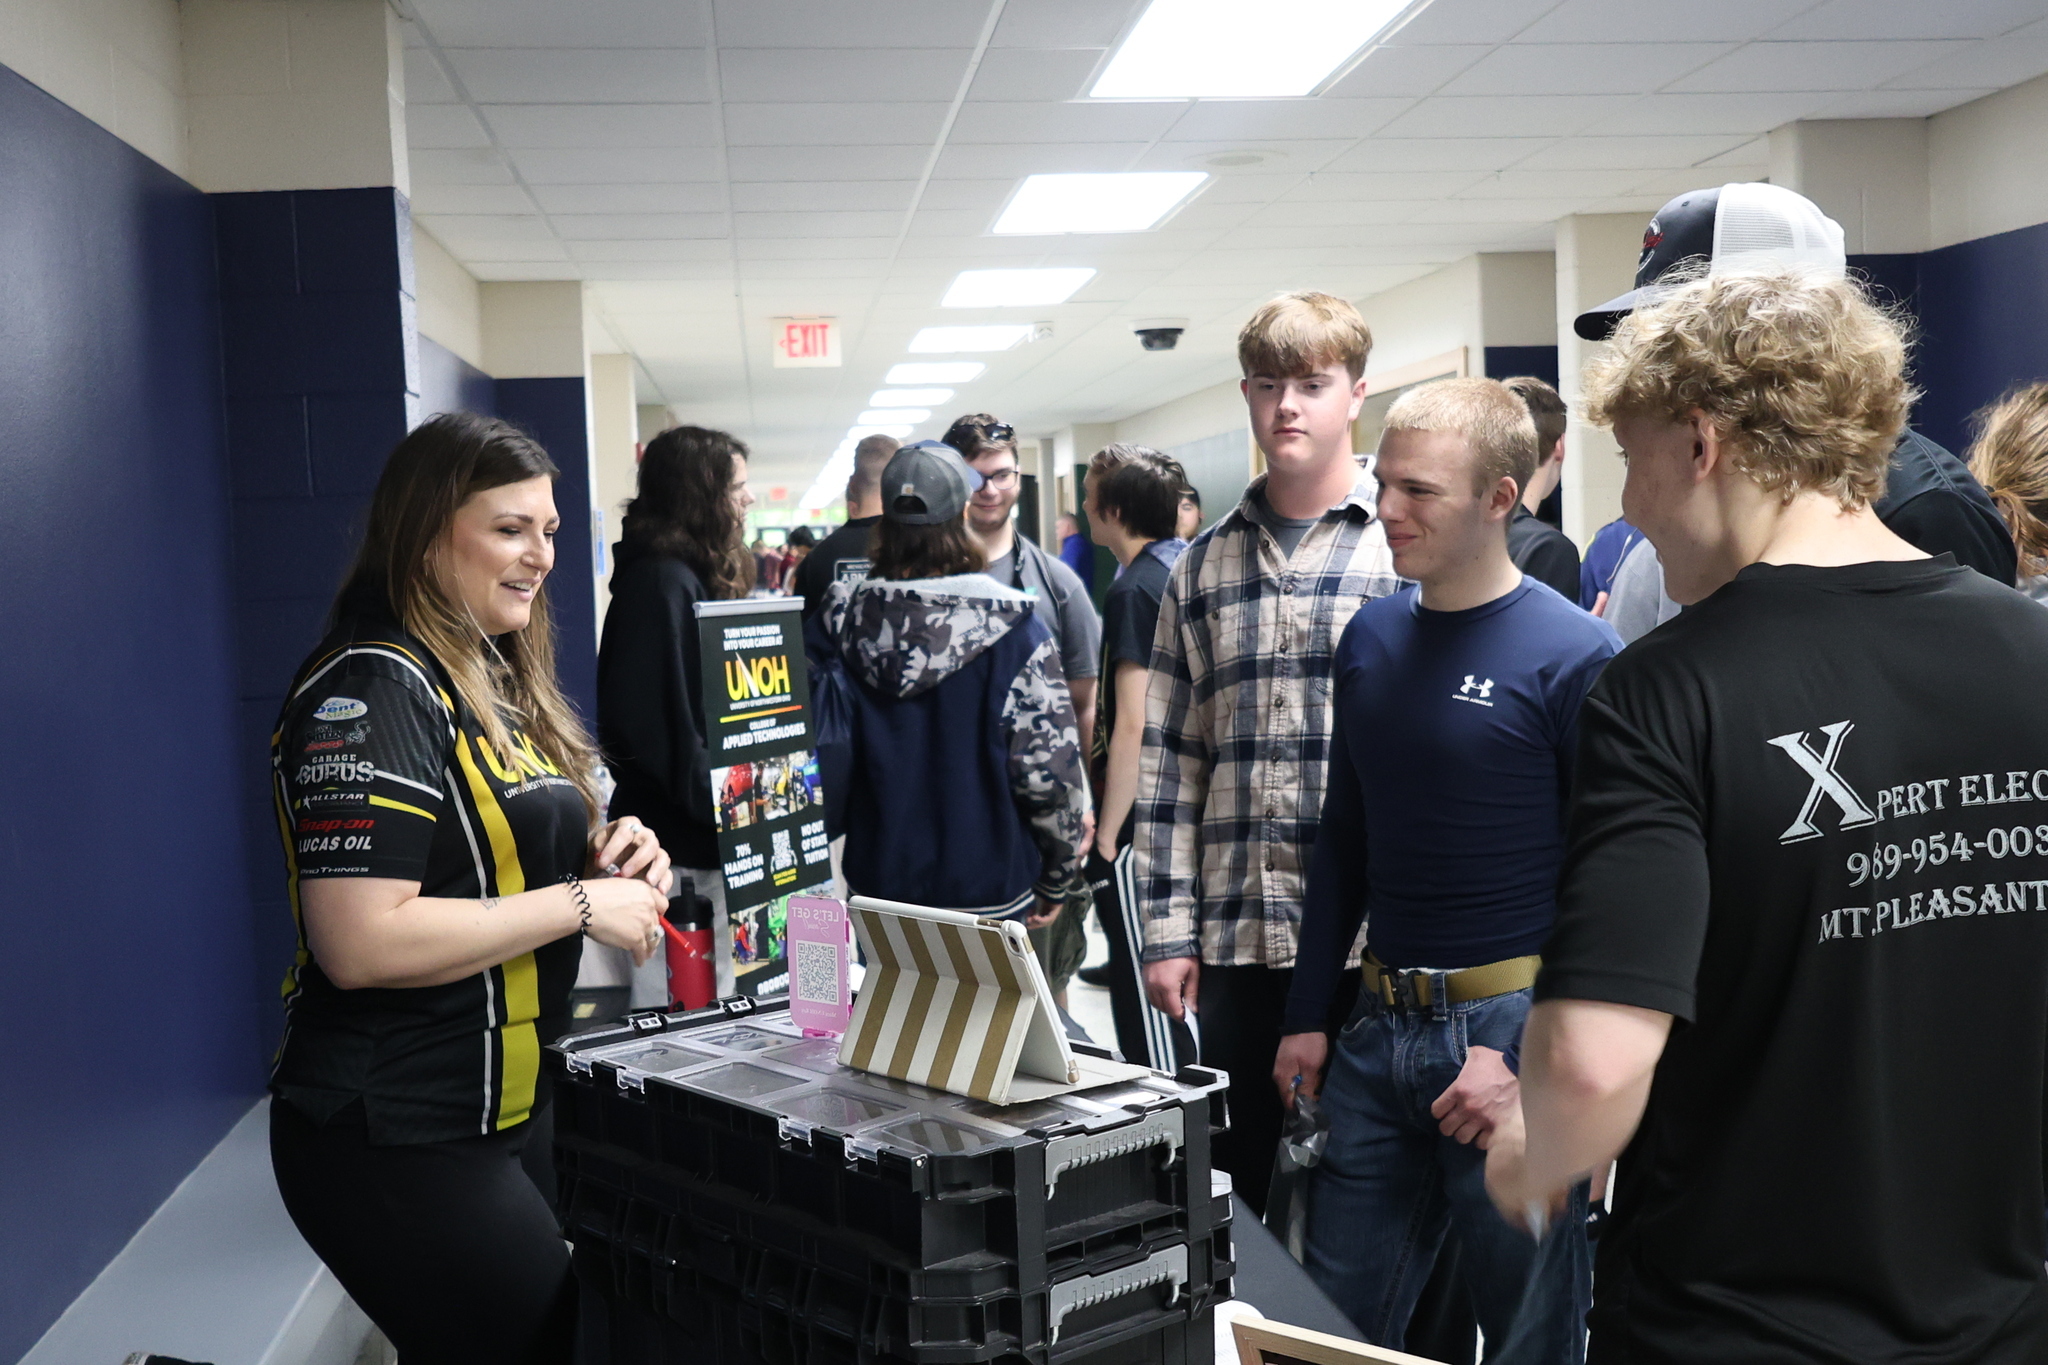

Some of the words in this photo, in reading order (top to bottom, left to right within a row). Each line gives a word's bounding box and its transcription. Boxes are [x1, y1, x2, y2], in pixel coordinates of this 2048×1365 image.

[786, 324, 828, 357] EXIT
[723, 628, 740, 639] TURN
[740, 626, 756, 637] YOUR
[756, 624, 781, 636] PASSION
[723, 640, 739, 651] INTO
[739, 638, 755, 649] YOUR
[755, 636, 776, 648] CAREER
[776, 634, 783, 646] AT
[725, 653, 790, 701] UNOH
[749, 719, 768, 731] COLLEGE
[768, 717, 777, 727] OF
[722, 731, 754, 751] APPLIED
[753, 721, 806, 744] TECHNOLOGIES
[311, 754, 357, 763] GARAGE
[1959, 769, 2048, 807] ELEC
[310, 793, 365, 802] ALLSTAR
[298, 818, 376, 832] Snap-on
[801, 824, 812, 837] NO
[811, 820, 824, 834] OUT
[299, 836, 341, 853] LUCAS
[344, 835, 372, 851] OIL
[735, 843, 752, 858] 70%
[802, 838, 811, 851] OF
[810, 834, 828, 849] STATE
[725, 858, 753, 876] HANDS
[752, 854, 764, 868] ON
[804, 848, 829, 865] TUITION
[728, 868, 764, 889] TRAINING
[1876, 879, 2048, 933] PLEASANT
